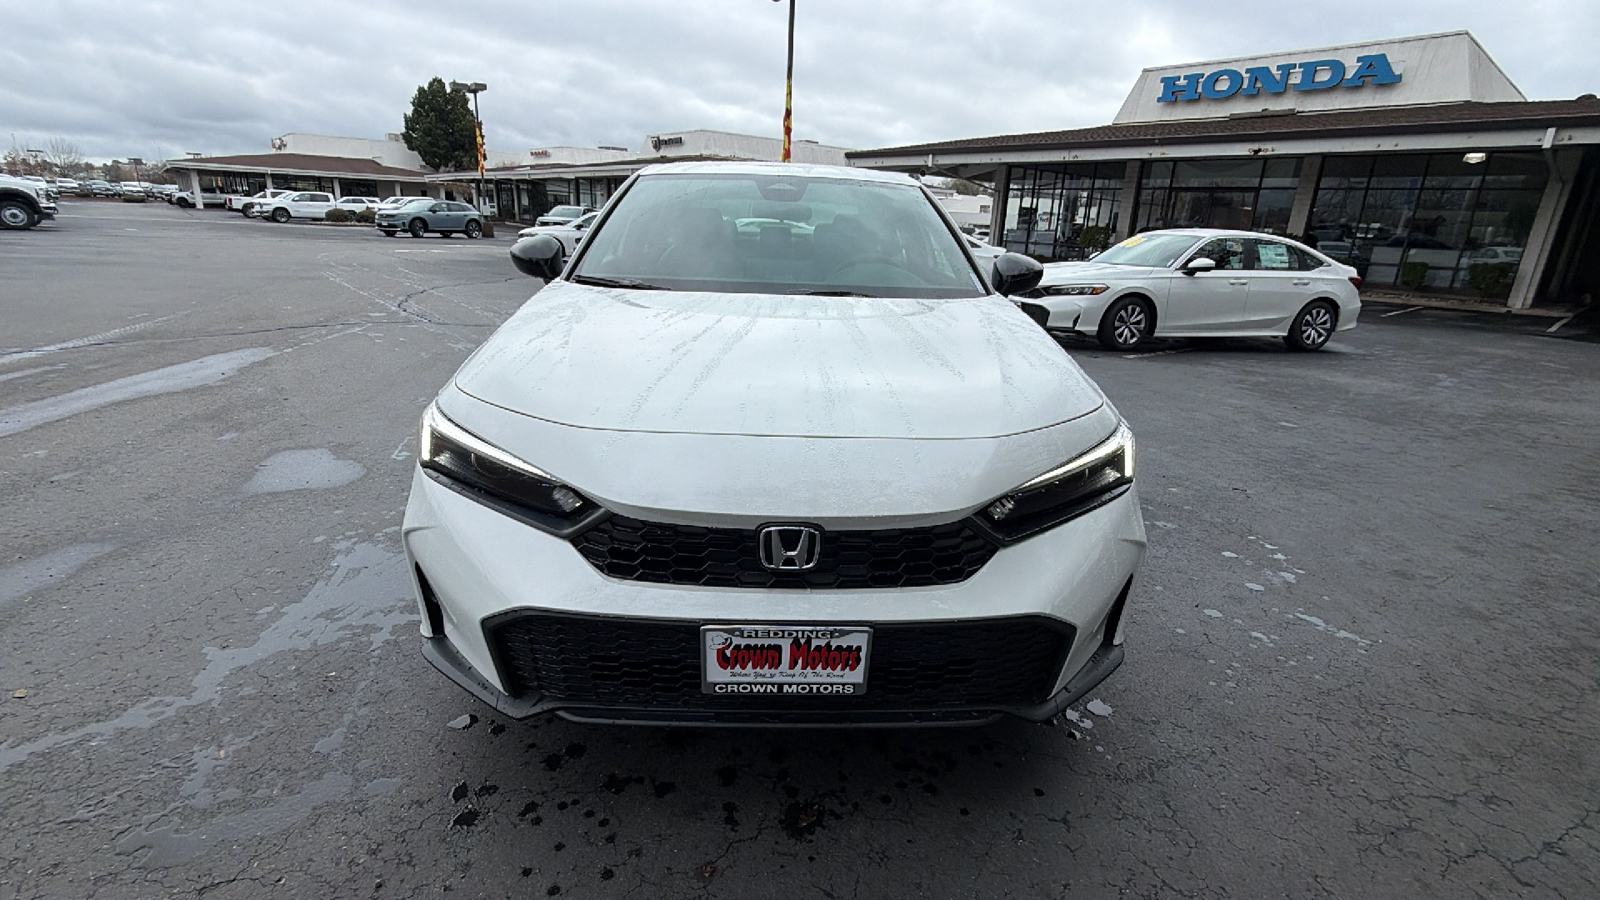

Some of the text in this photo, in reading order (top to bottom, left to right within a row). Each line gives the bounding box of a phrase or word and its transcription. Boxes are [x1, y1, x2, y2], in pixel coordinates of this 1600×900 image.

[1157, 53, 1402, 103] HONDA
[743, 630, 831, 639] REDDING
[716, 640, 860, 671] Crown Motors
[778, 671, 796, 679] King
[798, 671, 808, 679] Of
[715, 684, 854, 694] CROWN MOTORS
